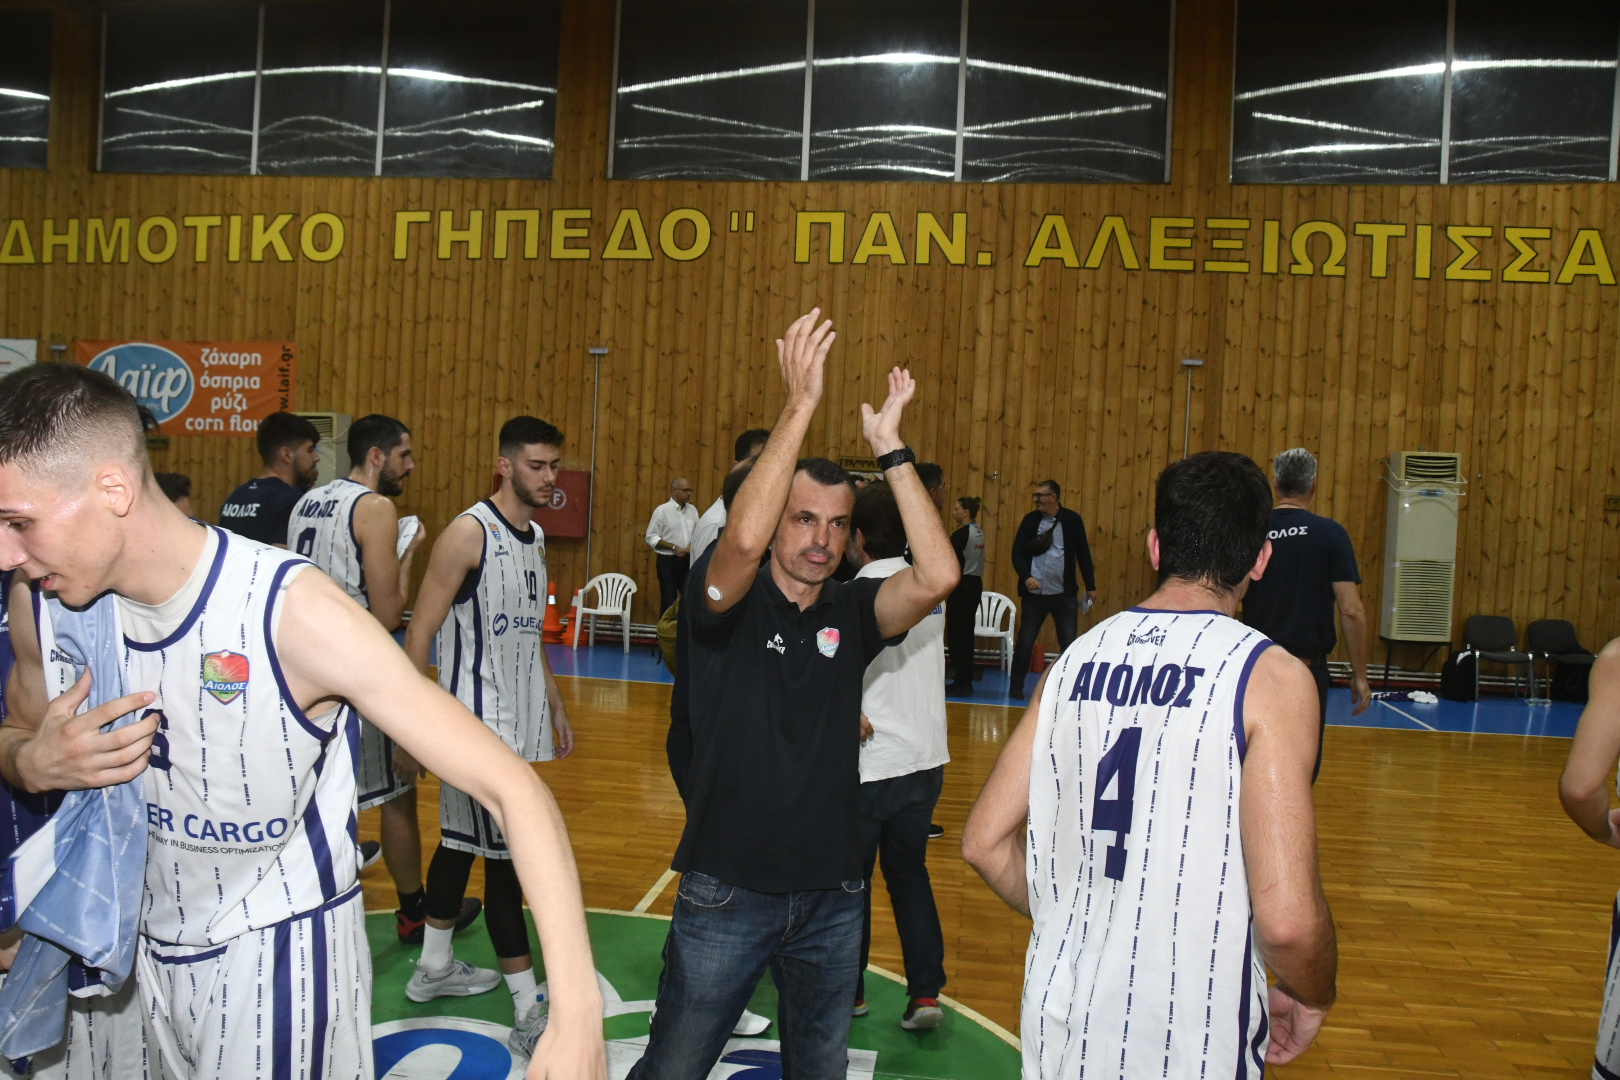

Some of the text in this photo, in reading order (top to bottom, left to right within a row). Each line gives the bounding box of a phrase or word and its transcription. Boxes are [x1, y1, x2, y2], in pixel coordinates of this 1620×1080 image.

[0, 212, 345, 264] ΔΗΜΟΤΙΚΟ
[794, 211, 992, 266] ΠΑΝ.
[1023, 213, 1617, 286] ΑΛΕΞΙΩΤΙΣΣΑ
[200, 348, 262, 369] ζάχαρη
[199, 371, 261, 393] όσπρια
[210, 392, 248, 414] ρύζι
[185, 414, 261, 432] corn flou
[221, 503, 260, 518] ΑΙΟΛΟΣ
[297, 498, 339, 519] ΑΙΟΛΟΣ
[1266, 526, 1308, 540] ΟΛΟΣ
[1068, 661, 1206, 709] ΑΙΟΛΟΣ
[1091, 726, 1142, 882] 4
[183, 813, 288, 843] CARGO
[180, 841, 219, 854] BUSINESS
